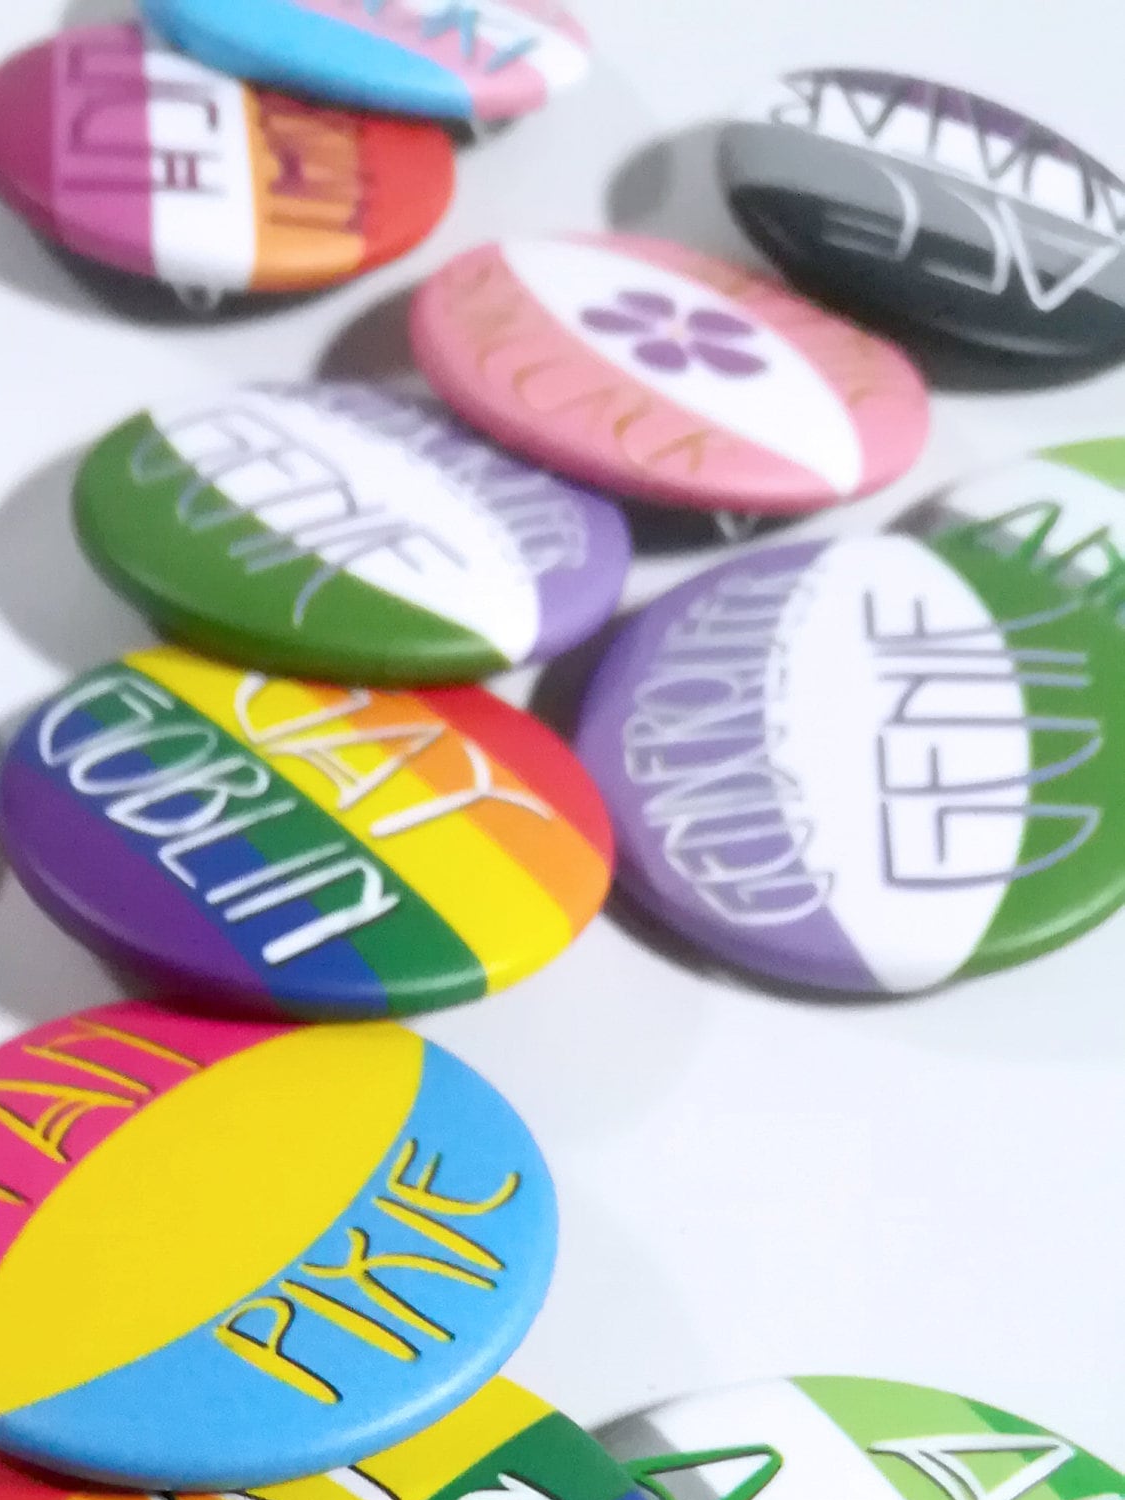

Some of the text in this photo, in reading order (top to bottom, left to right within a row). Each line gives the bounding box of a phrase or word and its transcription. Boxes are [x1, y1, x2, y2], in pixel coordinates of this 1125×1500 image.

[819, 156, 1123, 313] ACE
[38, 674, 401, 964] GOBLIN
[861, 590, 1105, 892] GENIE
[213, 1137, 521, 1405] PIXIE
